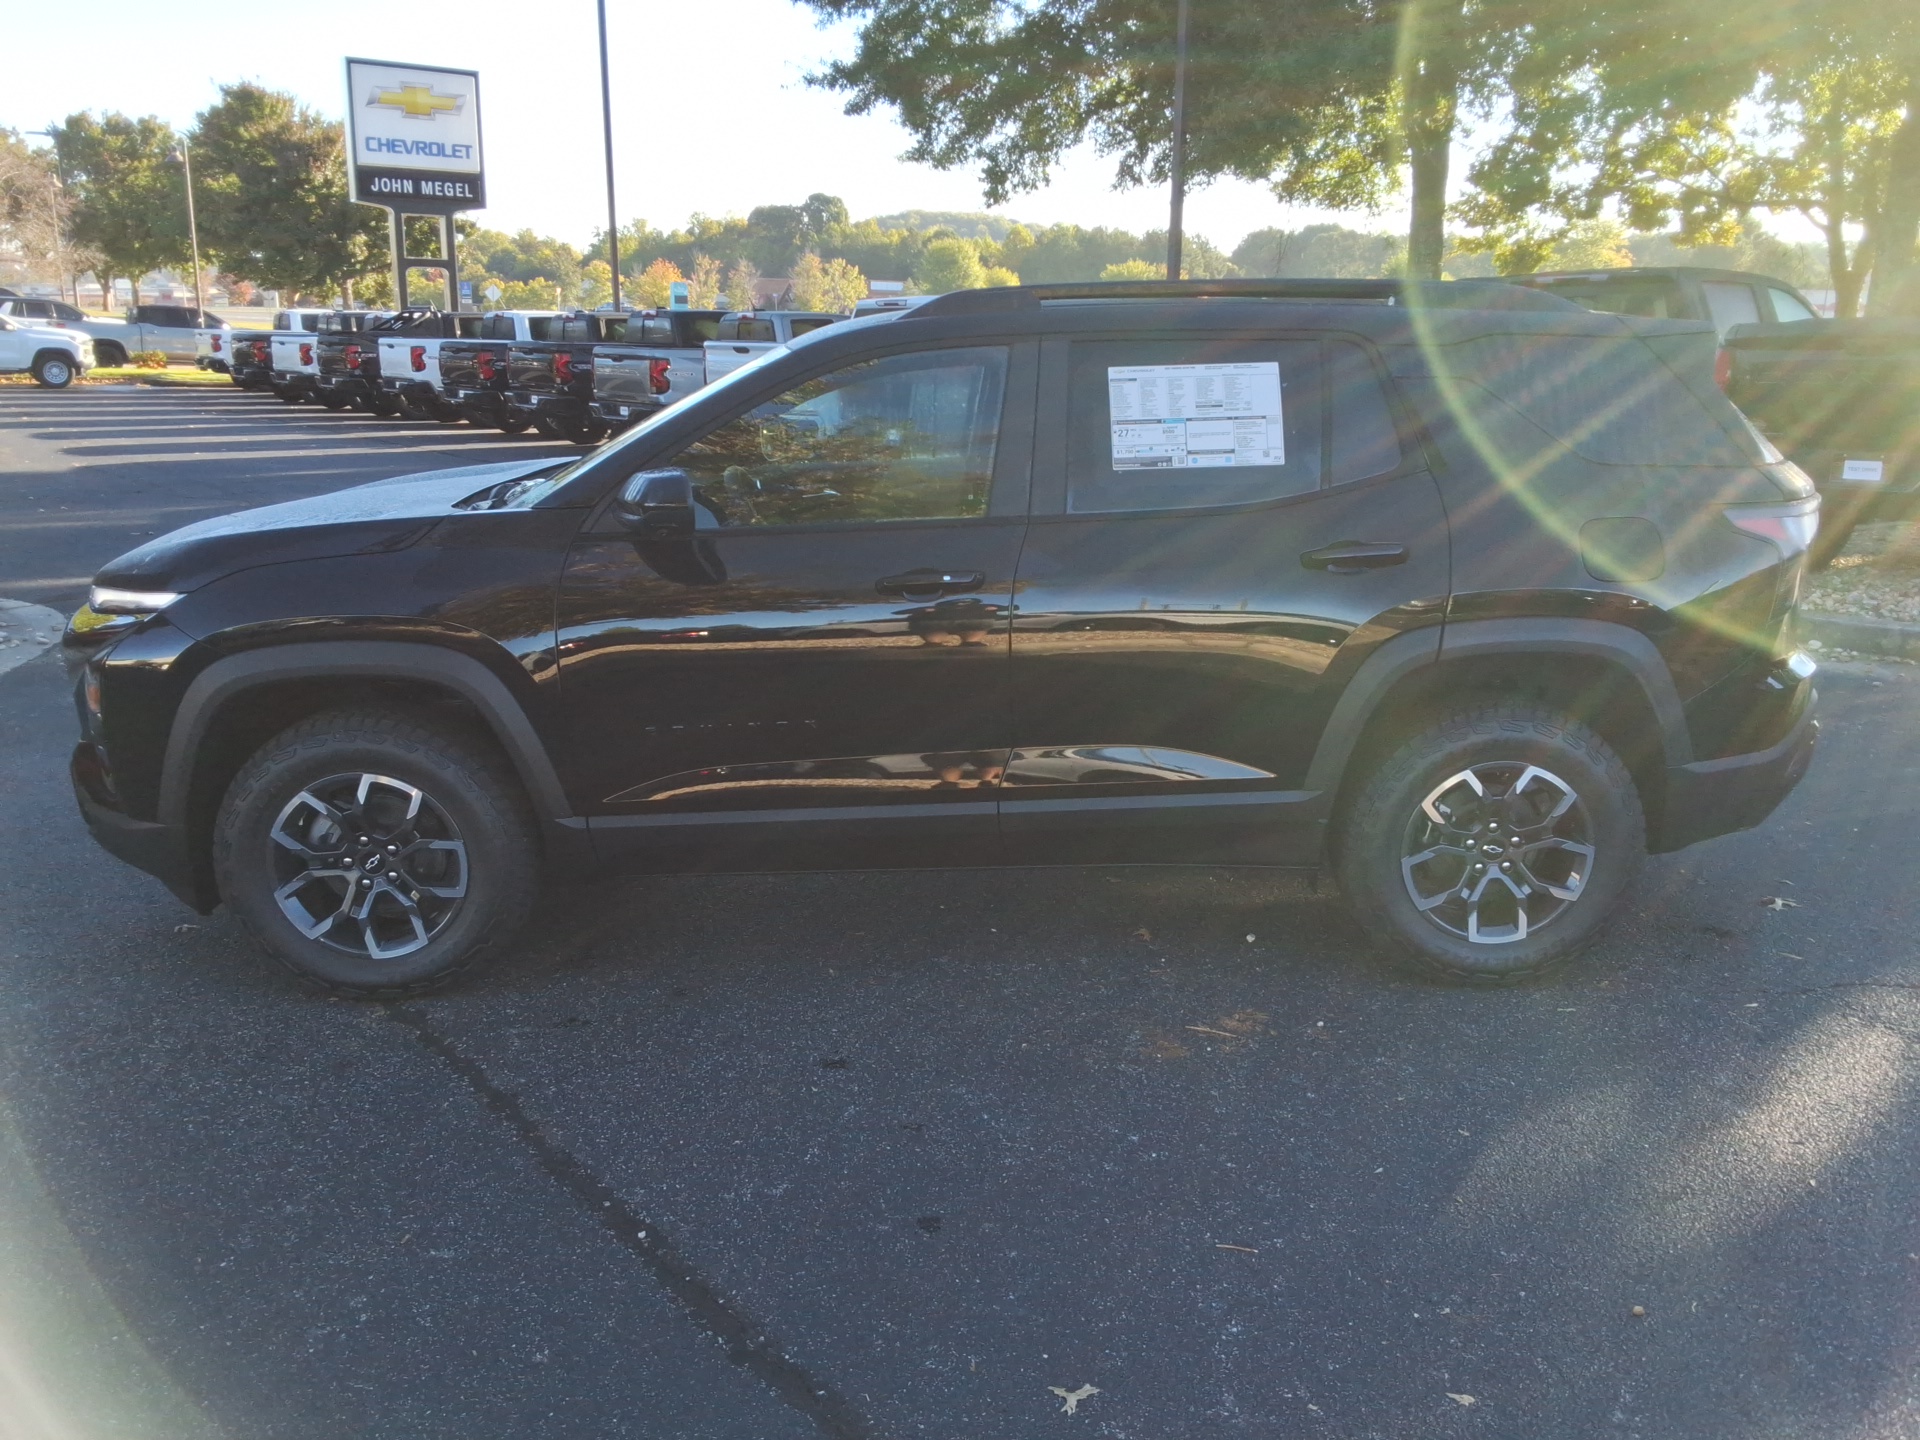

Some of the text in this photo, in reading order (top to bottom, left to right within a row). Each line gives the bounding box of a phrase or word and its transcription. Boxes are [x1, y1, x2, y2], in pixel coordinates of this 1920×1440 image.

[365, 136, 473, 160] CHEVROLET
[370, 177, 473, 198] JOHN MEGEL
[1117, 429, 1130, 438] 27
